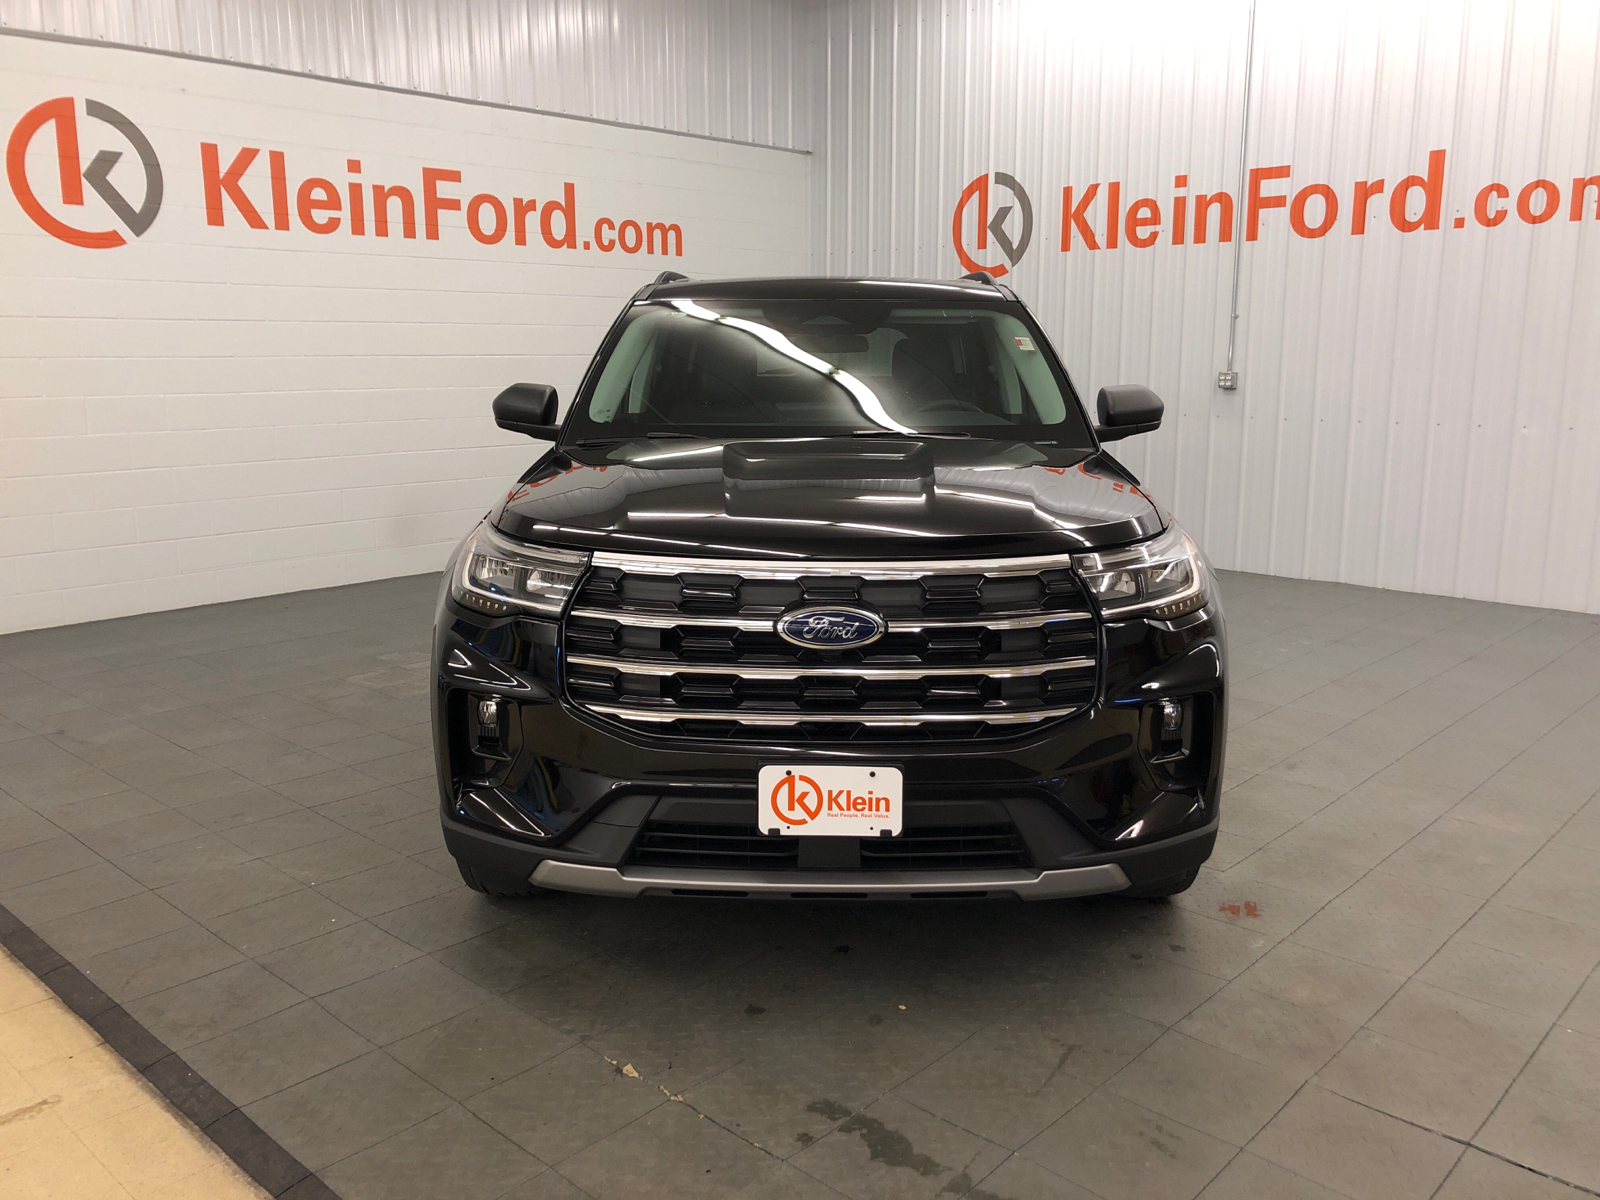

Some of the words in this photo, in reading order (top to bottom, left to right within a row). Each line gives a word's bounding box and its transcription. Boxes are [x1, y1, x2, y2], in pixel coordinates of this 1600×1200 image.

[200, 142, 684, 257] KleinFord.com
[802, 615, 860, 639] Ford
[827, 789, 891, 813] Klein
